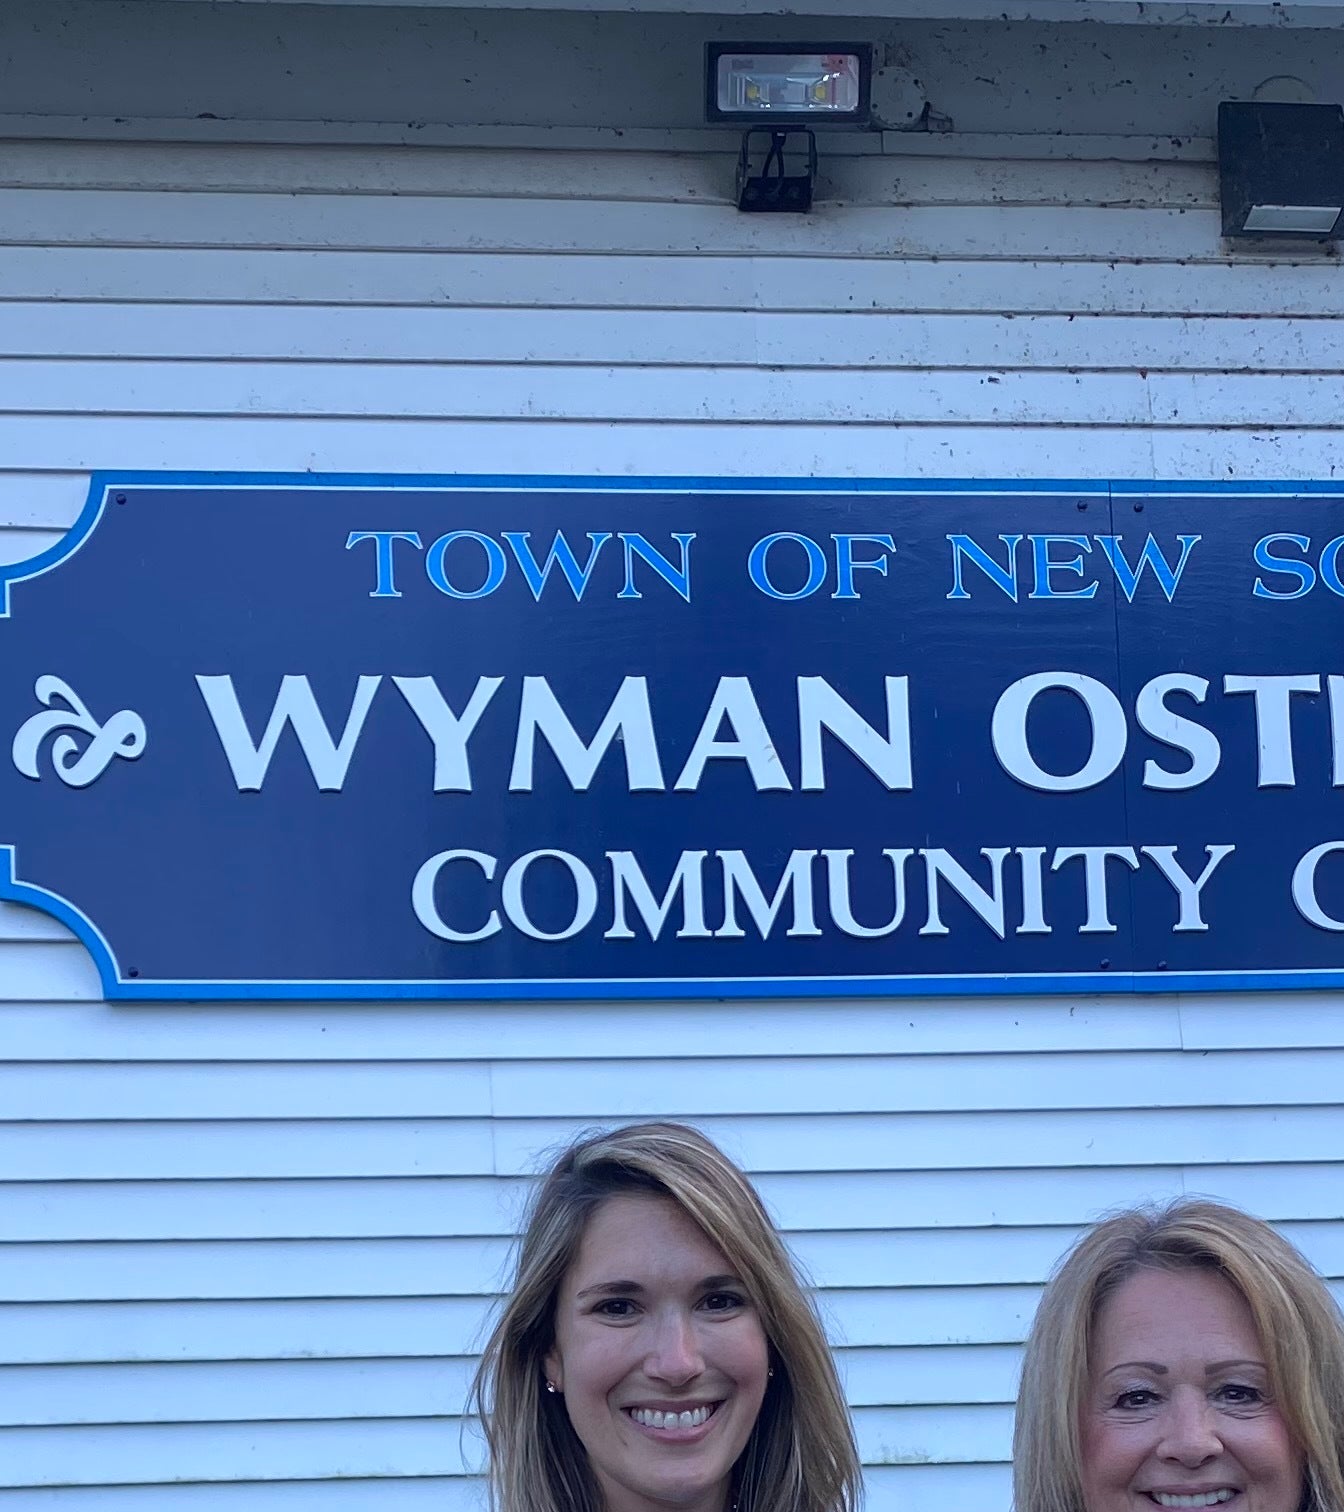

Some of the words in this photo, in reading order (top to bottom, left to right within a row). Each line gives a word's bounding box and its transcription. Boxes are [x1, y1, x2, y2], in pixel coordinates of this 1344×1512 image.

[345, 529, 696, 602] TOWN
[747, 529, 896, 601] OF
[945, 530, 1202, 603] NEW
[194, 673, 913, 793] WYMAN
[411, 842, 1235, 943] COMMUNITY
